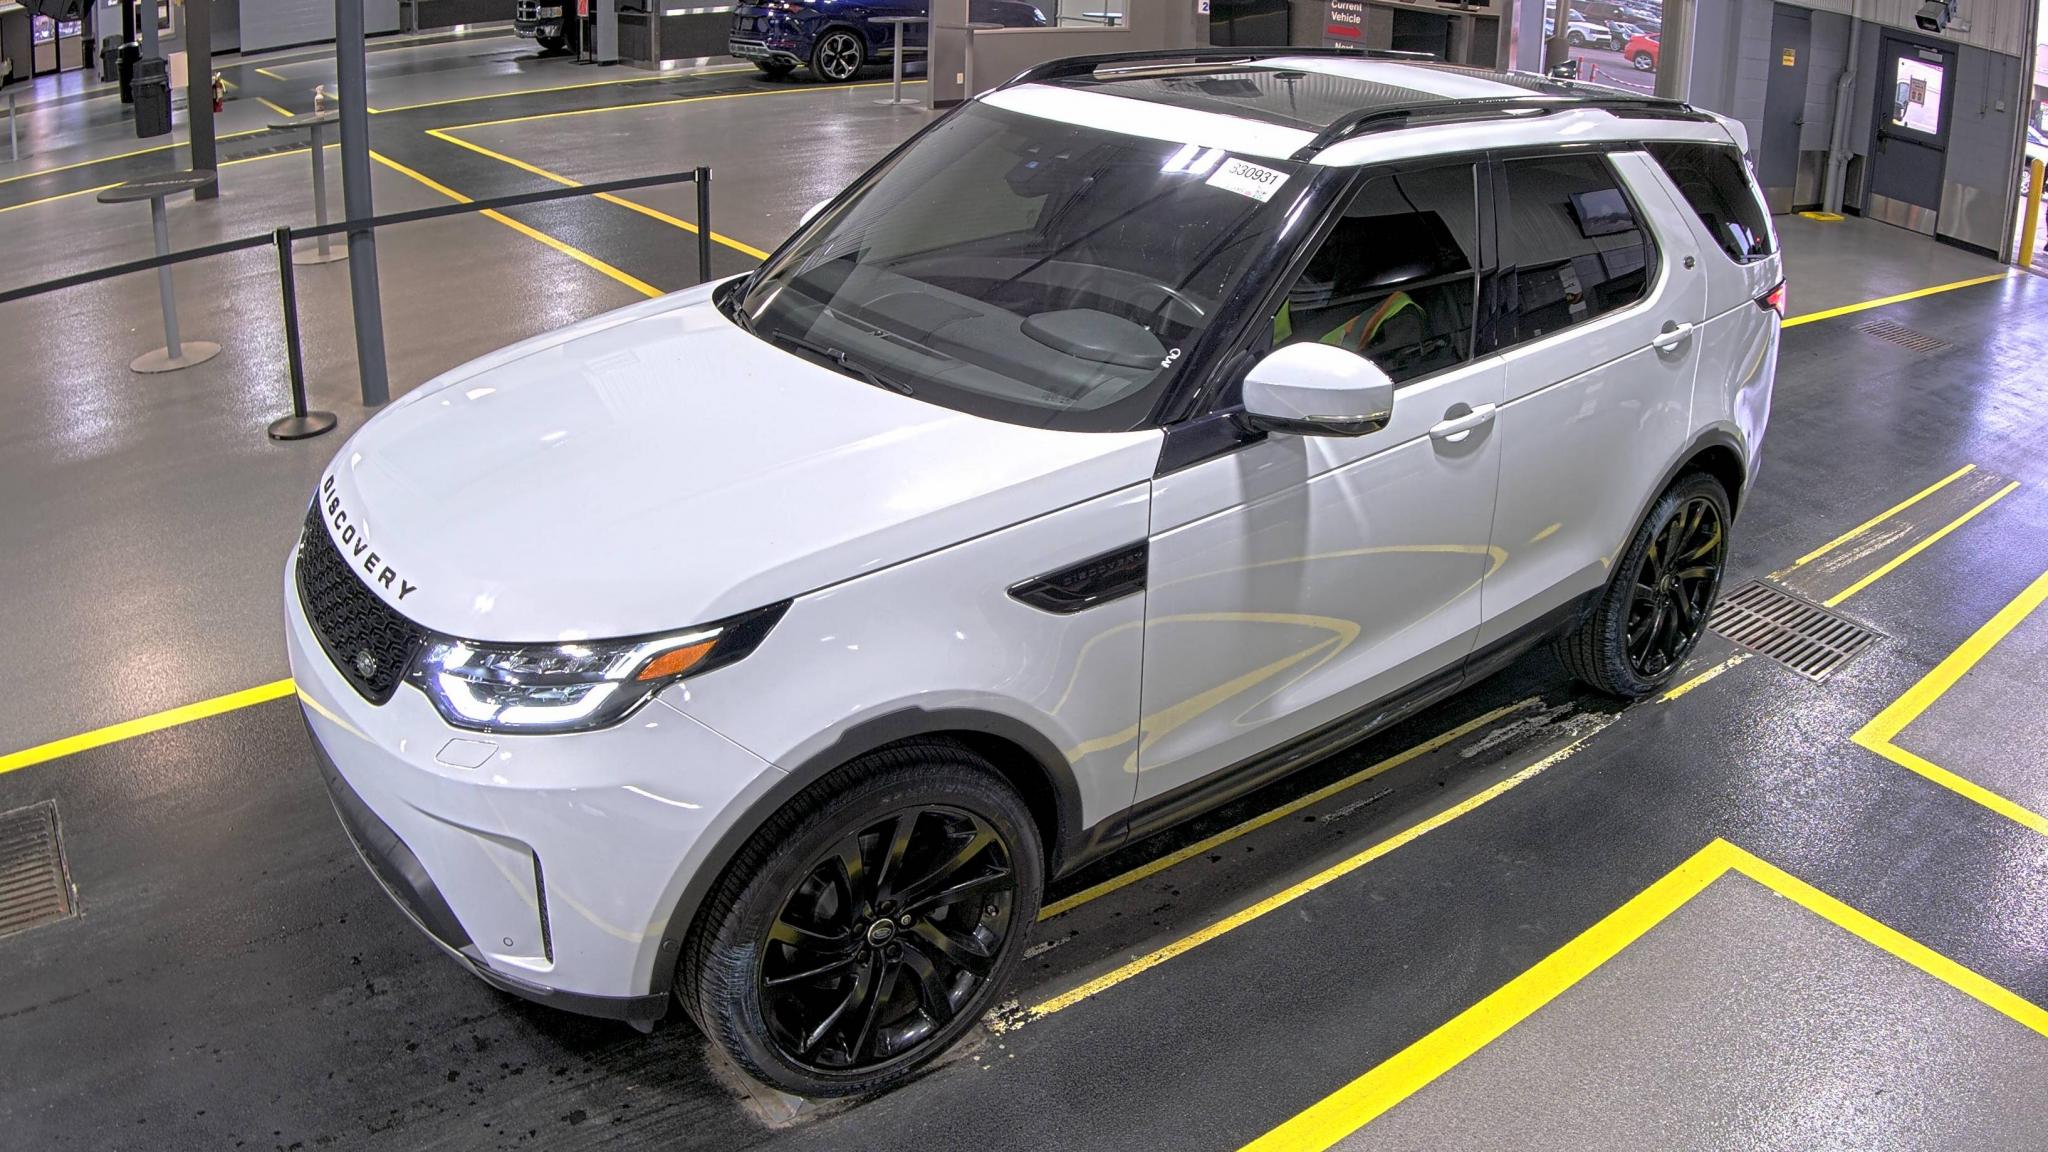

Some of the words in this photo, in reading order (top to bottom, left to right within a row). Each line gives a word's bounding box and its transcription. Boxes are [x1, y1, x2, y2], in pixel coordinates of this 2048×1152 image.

[1202, 1, 1209, 12] 2
[1331, 0, 1362, 12] Current
[1331, 11, 1361, 24] Vehicle
[323, 474, 417, 600] DISCOVERY
